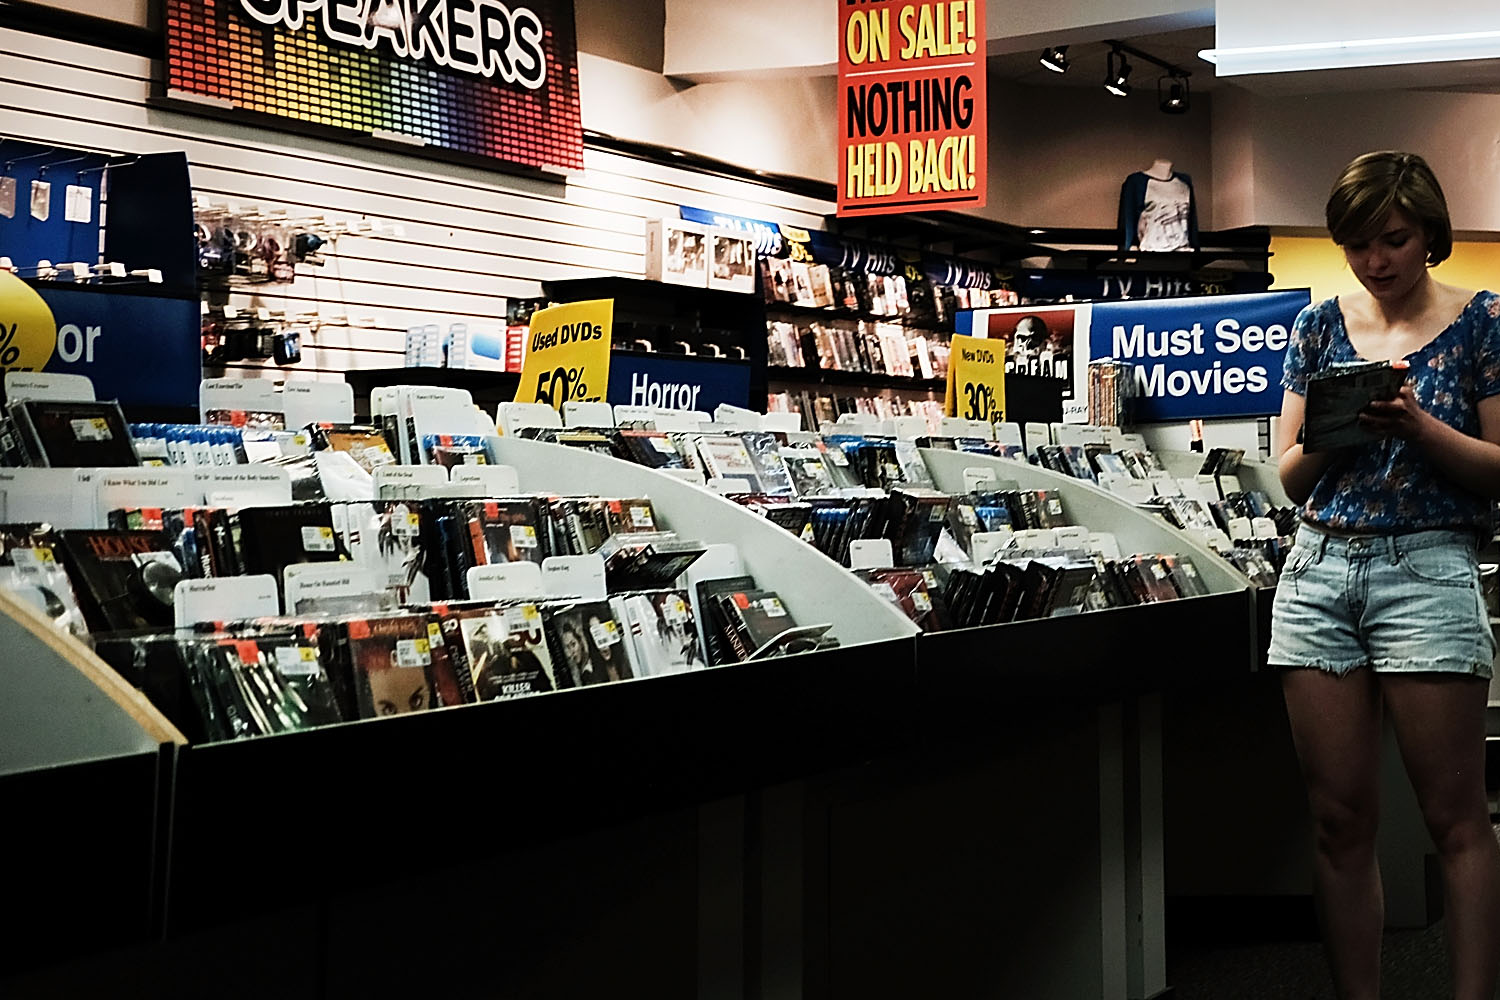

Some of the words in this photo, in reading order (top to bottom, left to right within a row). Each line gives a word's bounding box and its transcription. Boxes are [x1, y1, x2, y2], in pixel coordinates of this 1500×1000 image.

[847, 7, 890, 64] ON
[899, 0, 977, 61] SALE!
[847, 75, 974, 138] NOTHING
[846, 141, 902, 199] HELD
[909, 135, 976, 194] BACK!
[839, 242, 860, 268] TV
[864, 251, 896, 274] Hits
[945, 261, 962, 285] TV
[964, 265, 991, 289] Hits
[1097, 276, 1132, 299] TV
[1143, 277, 1191, 298] Hits
[532, 327, 557, 352] Used
[561, 322, 602, 345] DVDs
[962, 348, 975, 361] New
[1112, 323, 1205, 360] Must
[1214, 318, 1288, 352] See
[535, 366, 588, 410] 50%
[631, 373, 701, 411] Horror
[1134, 361, 1268, 398] Movies
[964, 382, 996, 421] 30%
[502, 682, 531, 695] KILLER
